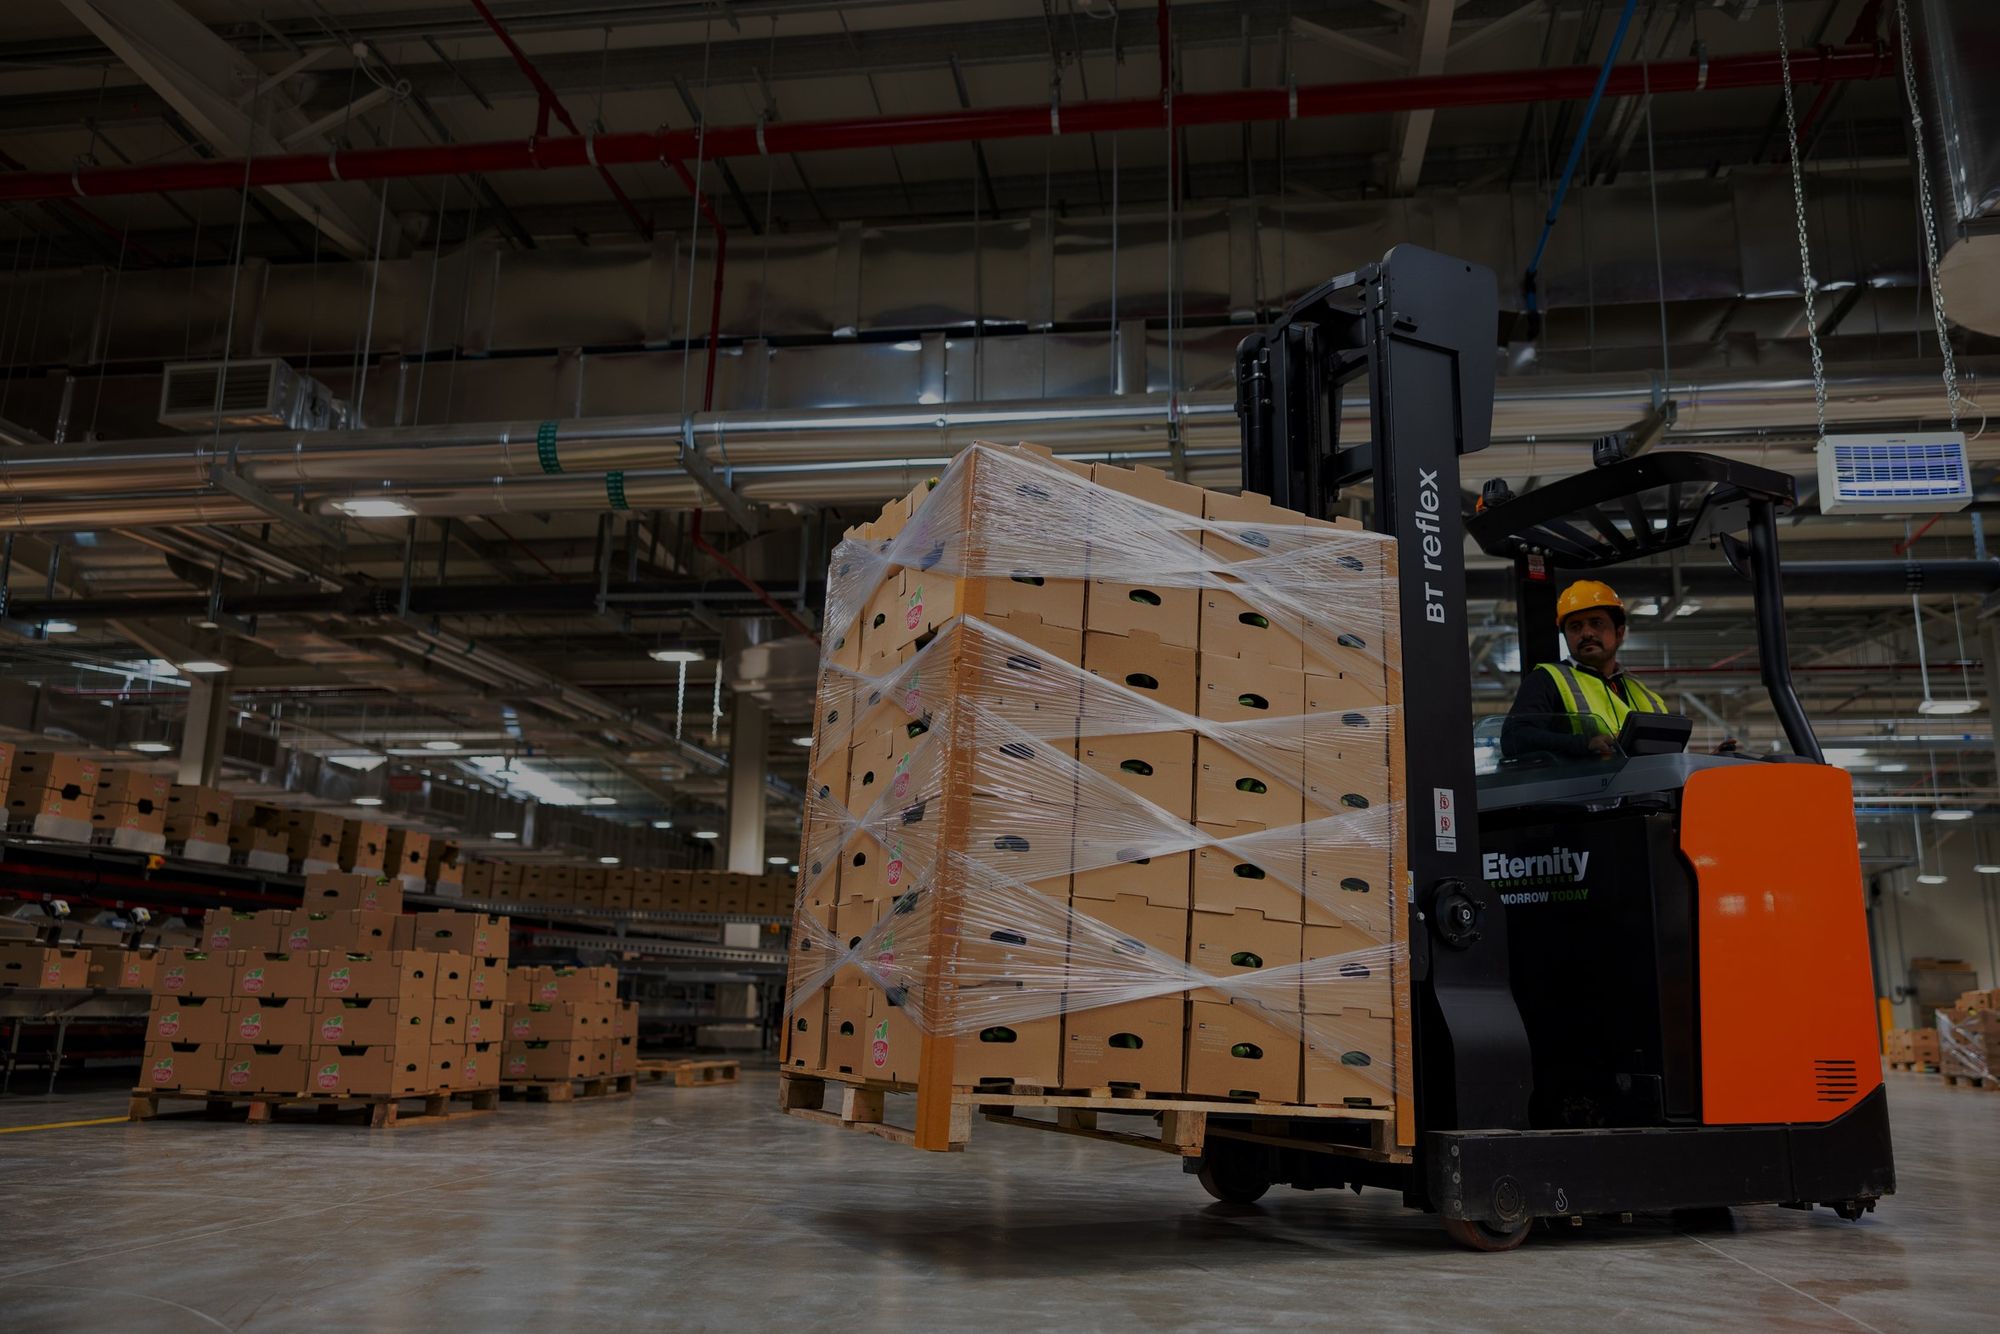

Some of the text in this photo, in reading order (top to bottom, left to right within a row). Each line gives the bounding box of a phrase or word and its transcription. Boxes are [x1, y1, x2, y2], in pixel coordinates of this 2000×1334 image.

[1415, 467, 1446, 624] BT reflex
[1482, 847, 1589, 882] Eternity
[1488, 875, 1574, 888] ECHNOLOGIES
[1500, 889, 1589, 904] MORROW TODAY
